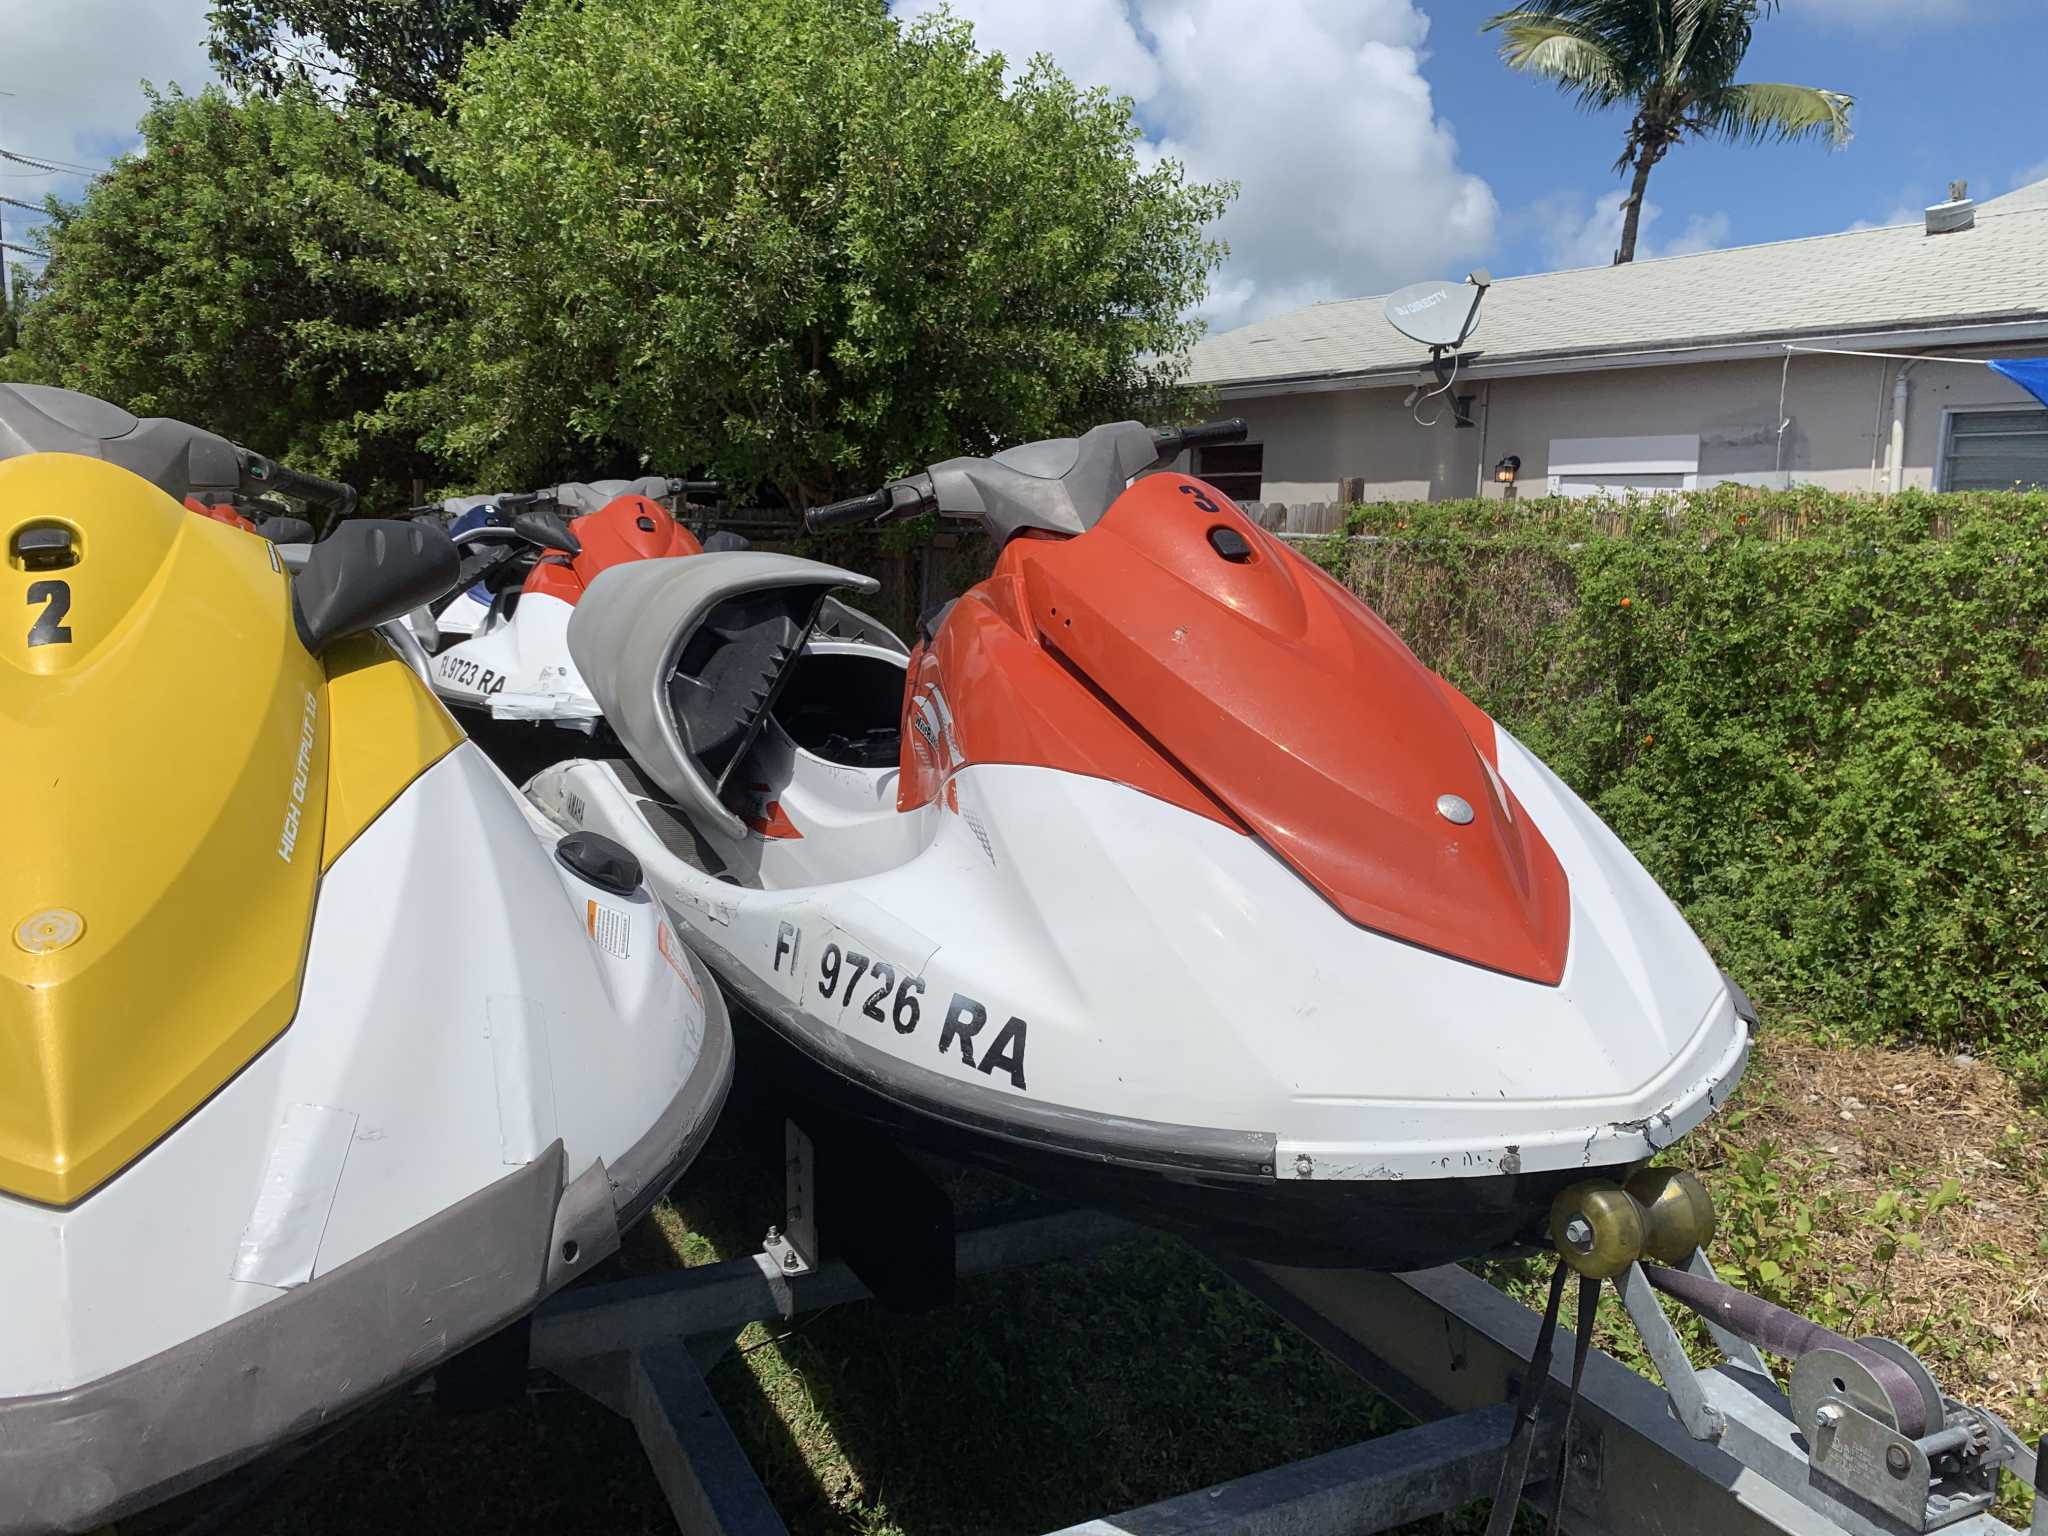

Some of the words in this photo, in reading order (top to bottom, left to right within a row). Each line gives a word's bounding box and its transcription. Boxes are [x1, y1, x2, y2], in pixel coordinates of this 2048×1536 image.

[635, 502, 646, 514] 1
[1179, 485, 1220, 513] 3
[27, 579, 72, 648] 2
[448, 657, 479, 686] 9723
[477, 669, 506, 695] RA
[278, 802, 302, 864] HIGH
[293, 718, 315, 803] OUTPUT
[818, 943, 926, 1034] 9726
[938, 992, 1027, 1091] RA
